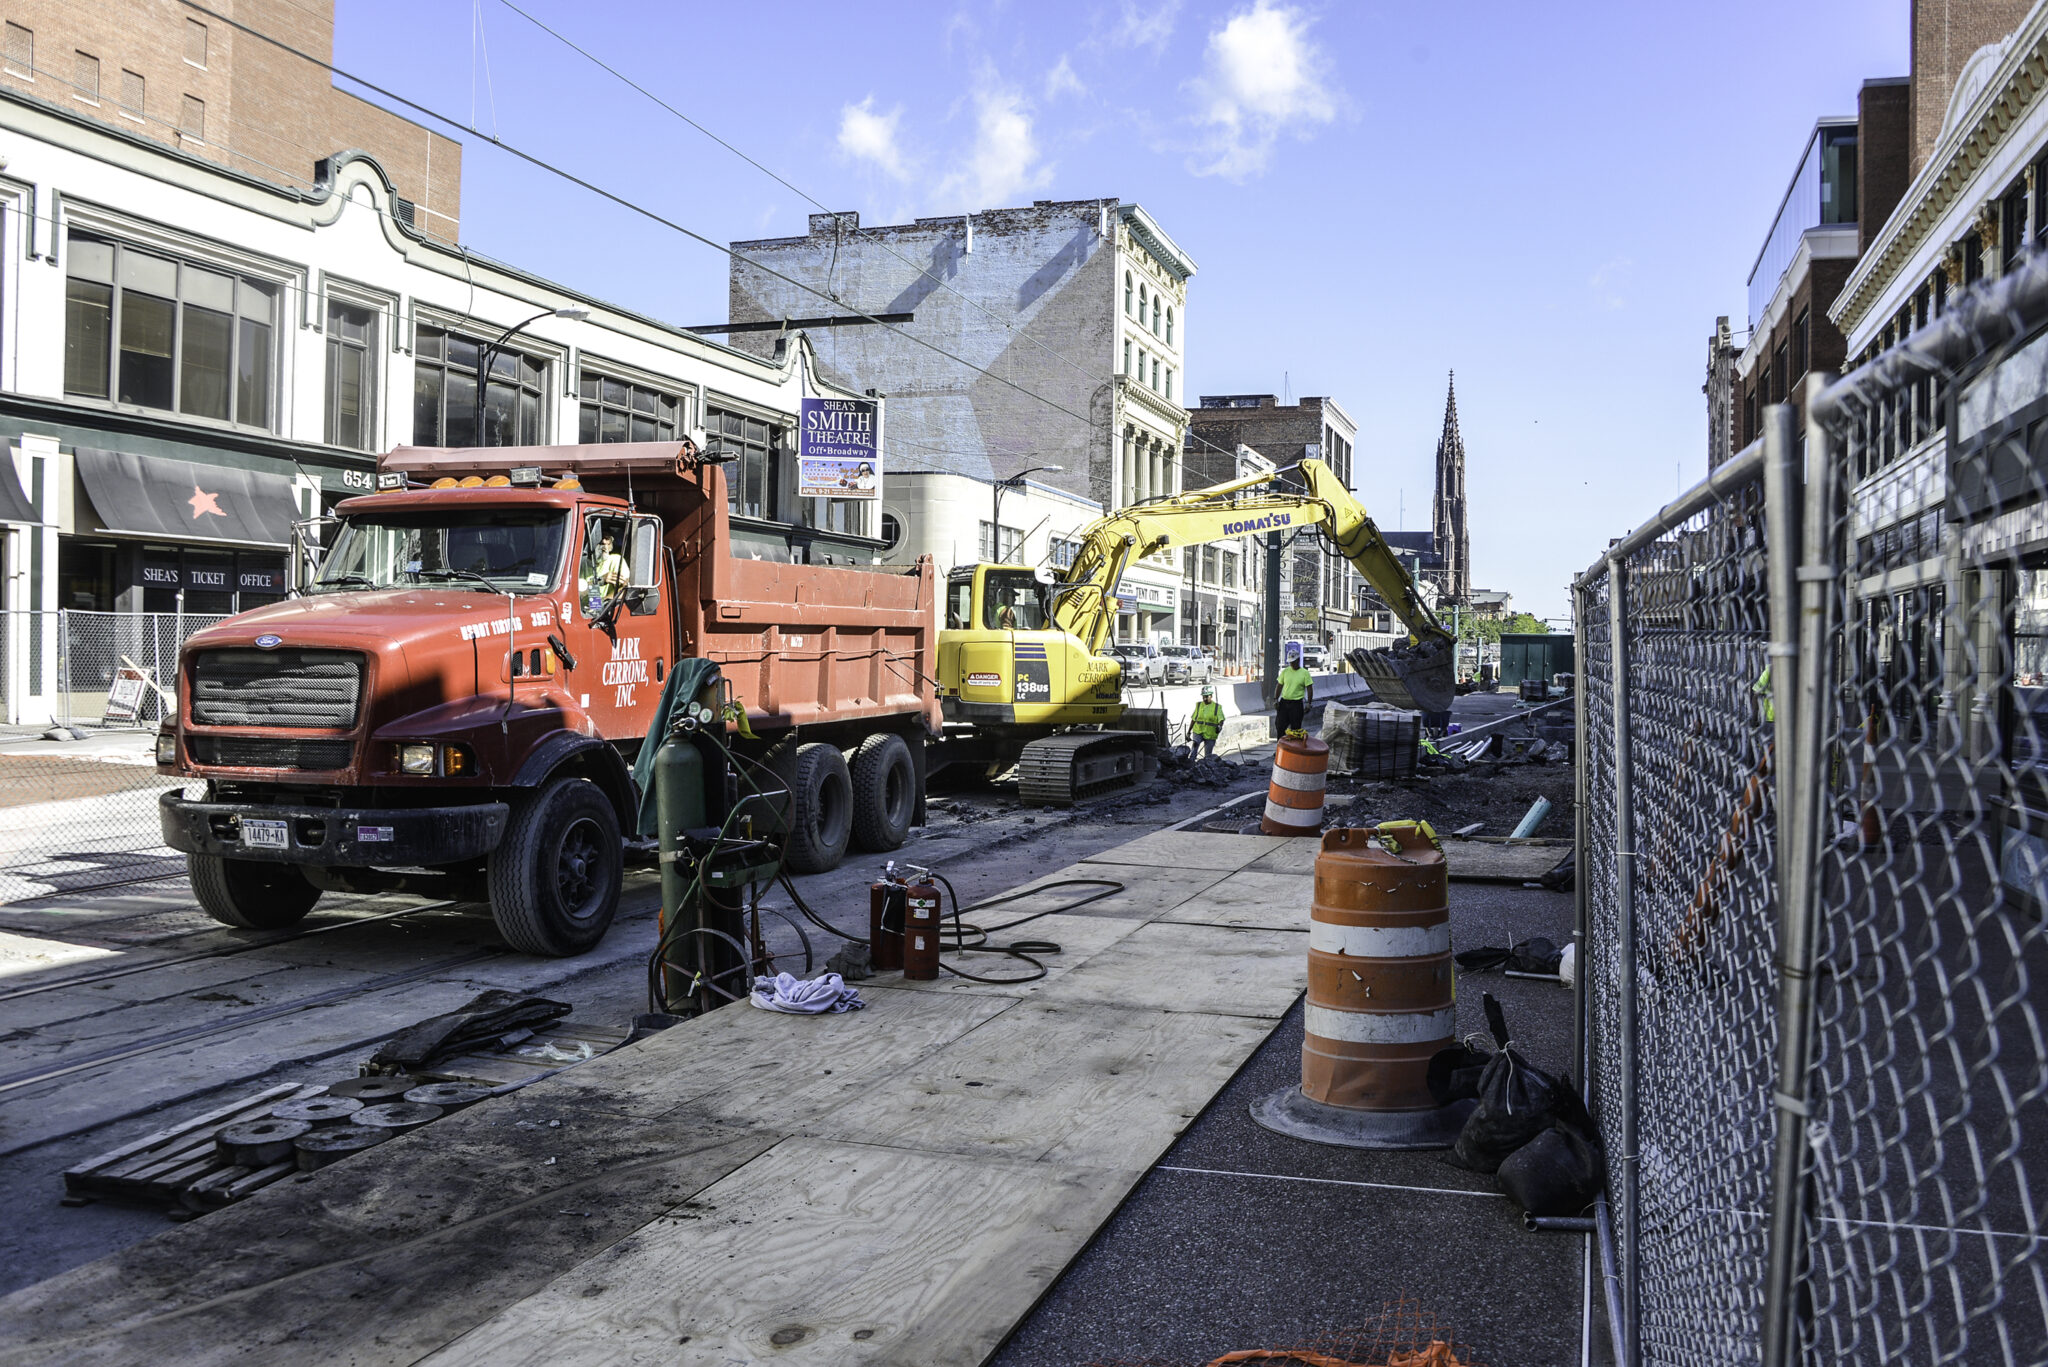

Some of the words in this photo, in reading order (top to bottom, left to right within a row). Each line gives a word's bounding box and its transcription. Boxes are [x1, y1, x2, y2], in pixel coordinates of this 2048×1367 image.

[824, 401, 856, 411] SHEA'S
[807, 410, 871, 431] SMITH
[807, 430, 871, 445] THEATRE
[343, 469, 373, 490] 654
[1223, 512, 1291, 535] KOMATSU
[144, 567, 179, 583] SHEA'S
[191, 571, 226, 585] TICKET
[240, 573, 272, 587] OFFICE
[460, 622, 490, 640] USDOT
[611, 637, 641, 661] MARK
[602, 660, 649, 687] CERRONE,
[1017, 673, 1029, 681] PC
[615, 683, 637, 708] INC.
